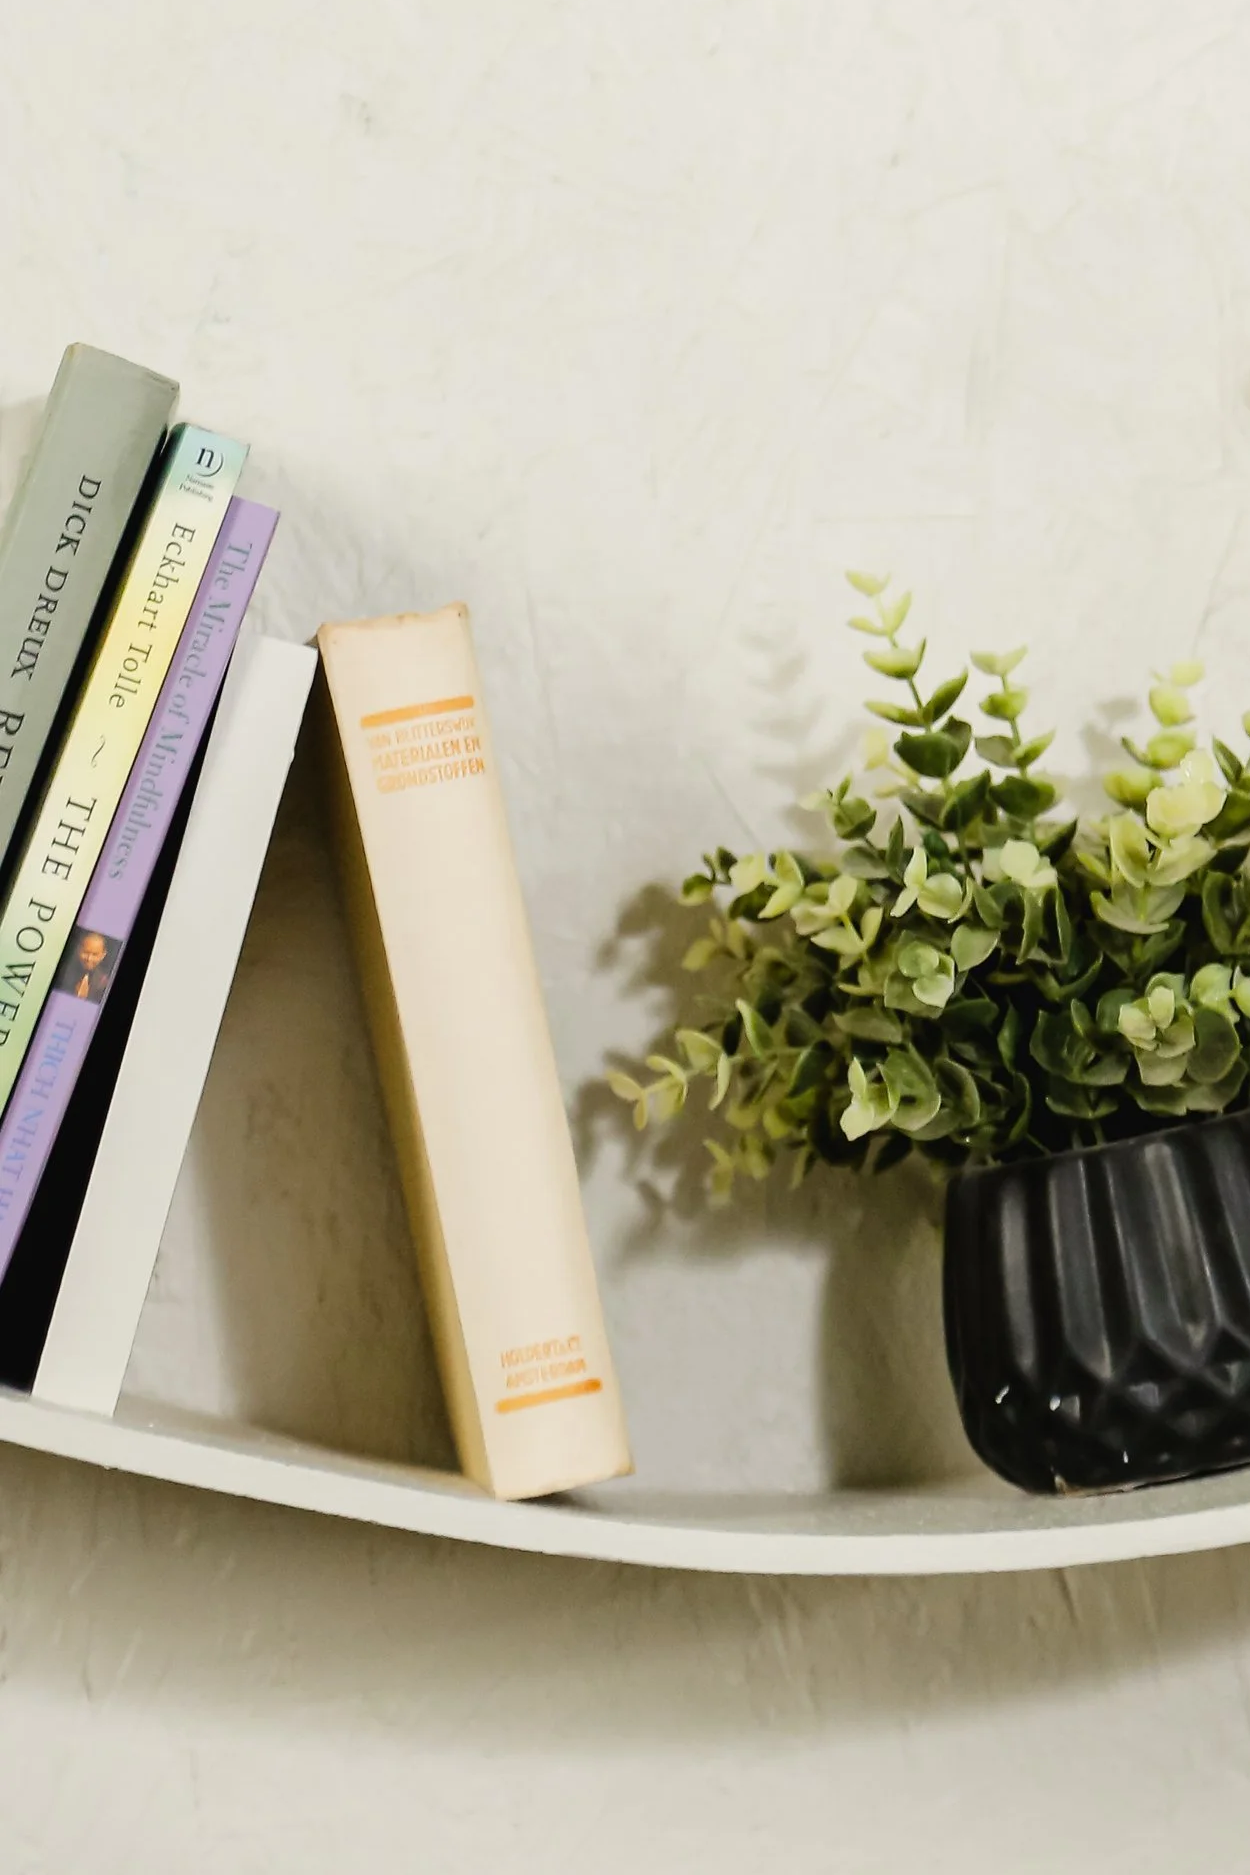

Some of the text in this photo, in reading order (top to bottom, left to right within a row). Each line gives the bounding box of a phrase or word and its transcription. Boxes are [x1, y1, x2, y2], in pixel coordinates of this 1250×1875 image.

[55, 474, 102, 557] DICK
[137, 522, 196, 632] Eckhart
[10, 566, 69, 681] DREUX
[107, 541, 253, 881] The Miracle of Mindfulness
[109, 643, 154, 709] Tolle
[41, 796, 98, 882] THE
[30, 1018, 77, 1101] THICH
[3, 1105, 46, 1183] NHAT
